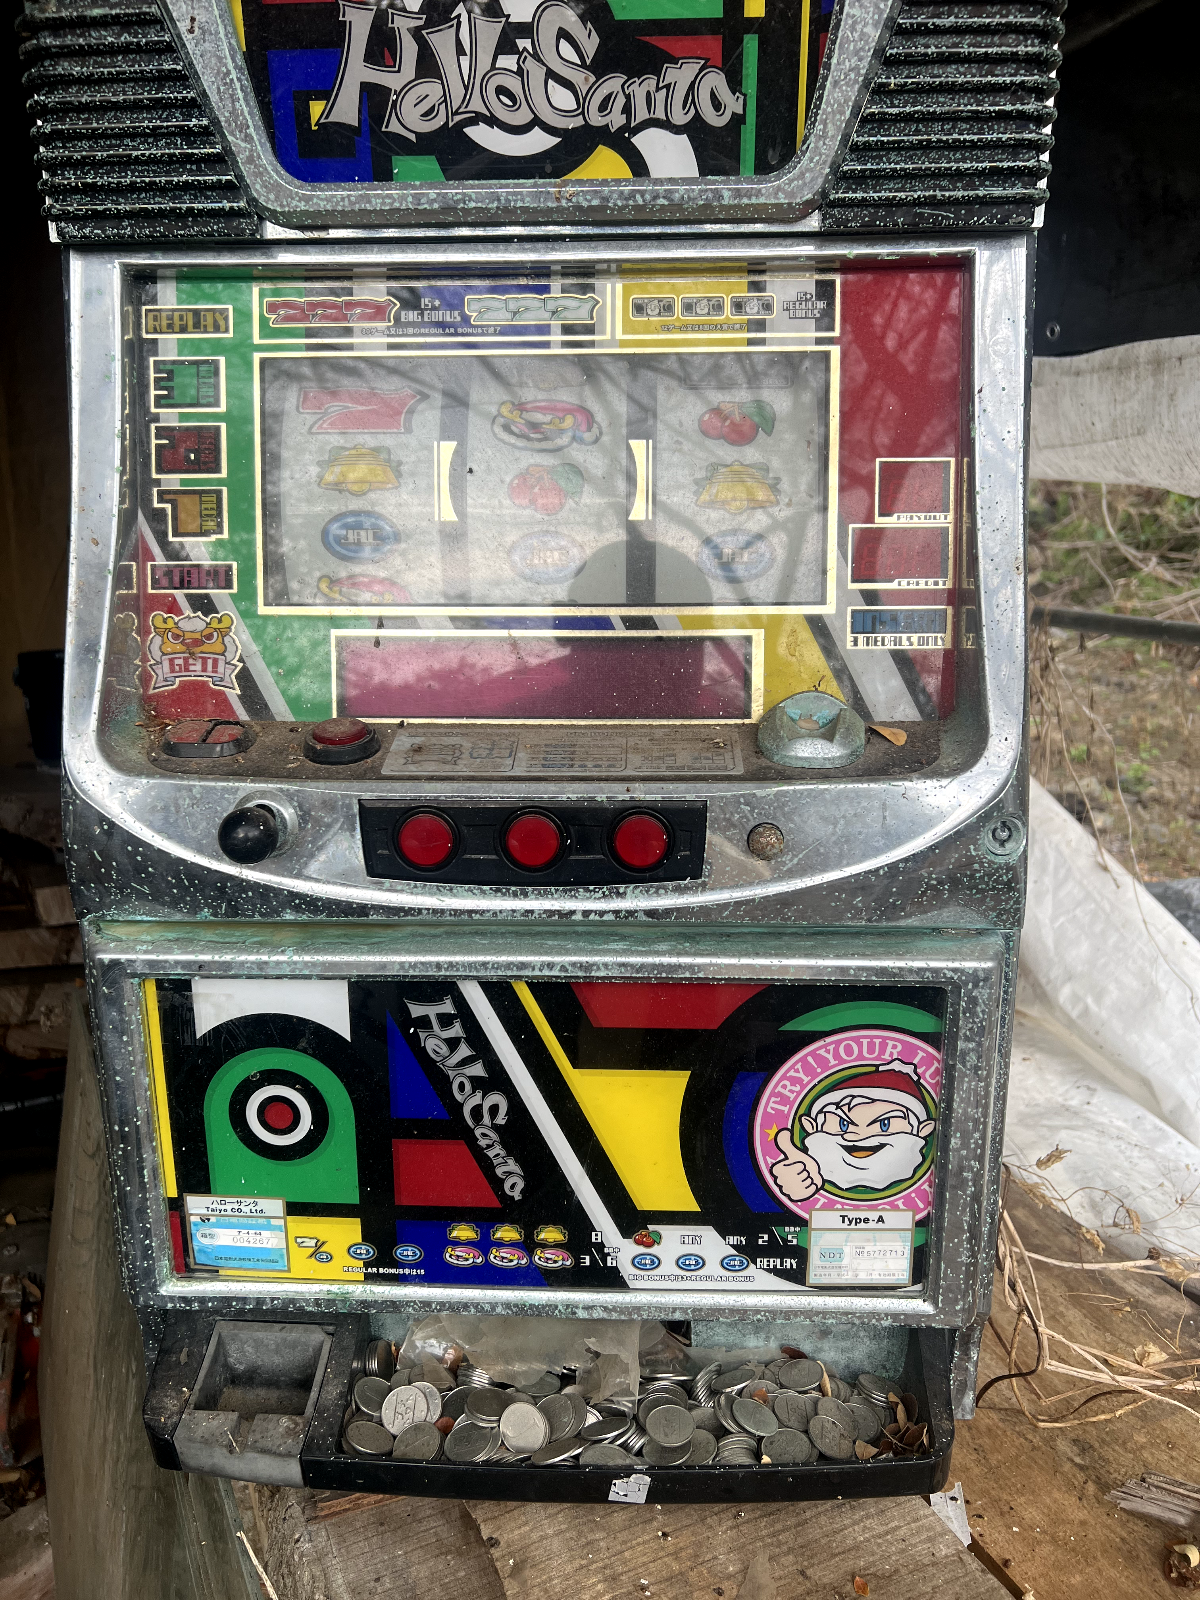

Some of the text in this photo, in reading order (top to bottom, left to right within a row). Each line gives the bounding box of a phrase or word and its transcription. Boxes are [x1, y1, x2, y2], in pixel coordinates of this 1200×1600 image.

[782, 300, 828, 310] REGULAR
[400, 310, 462, 322] BIG BONUS
[789, 309, 821, 319] BONUS
[147, 311, 228, 333] REPLAY
[201, 494, 217, 532] MEDAL
[152, 567, 229, 588] START
[897, 579, 949, 587] CREDIT
[862, 635, 915, 647] MEDALS
[916, 635, 946, 647] ONLY
[210, 1199, 259, 1208] ハローサンタ
[204, 1206, 228, 1214] Taiyo
[839, 1214, 886, 1227] Type-A
[232, 1236, 271, 1245] 004267
[756, 1257, 798, 1269] REPLAY
[342, 1265, 378, 1274] REGULAR
[628, 1273, 643, 1281] BIG
[728, 1275, 756, 1283] BONUS
